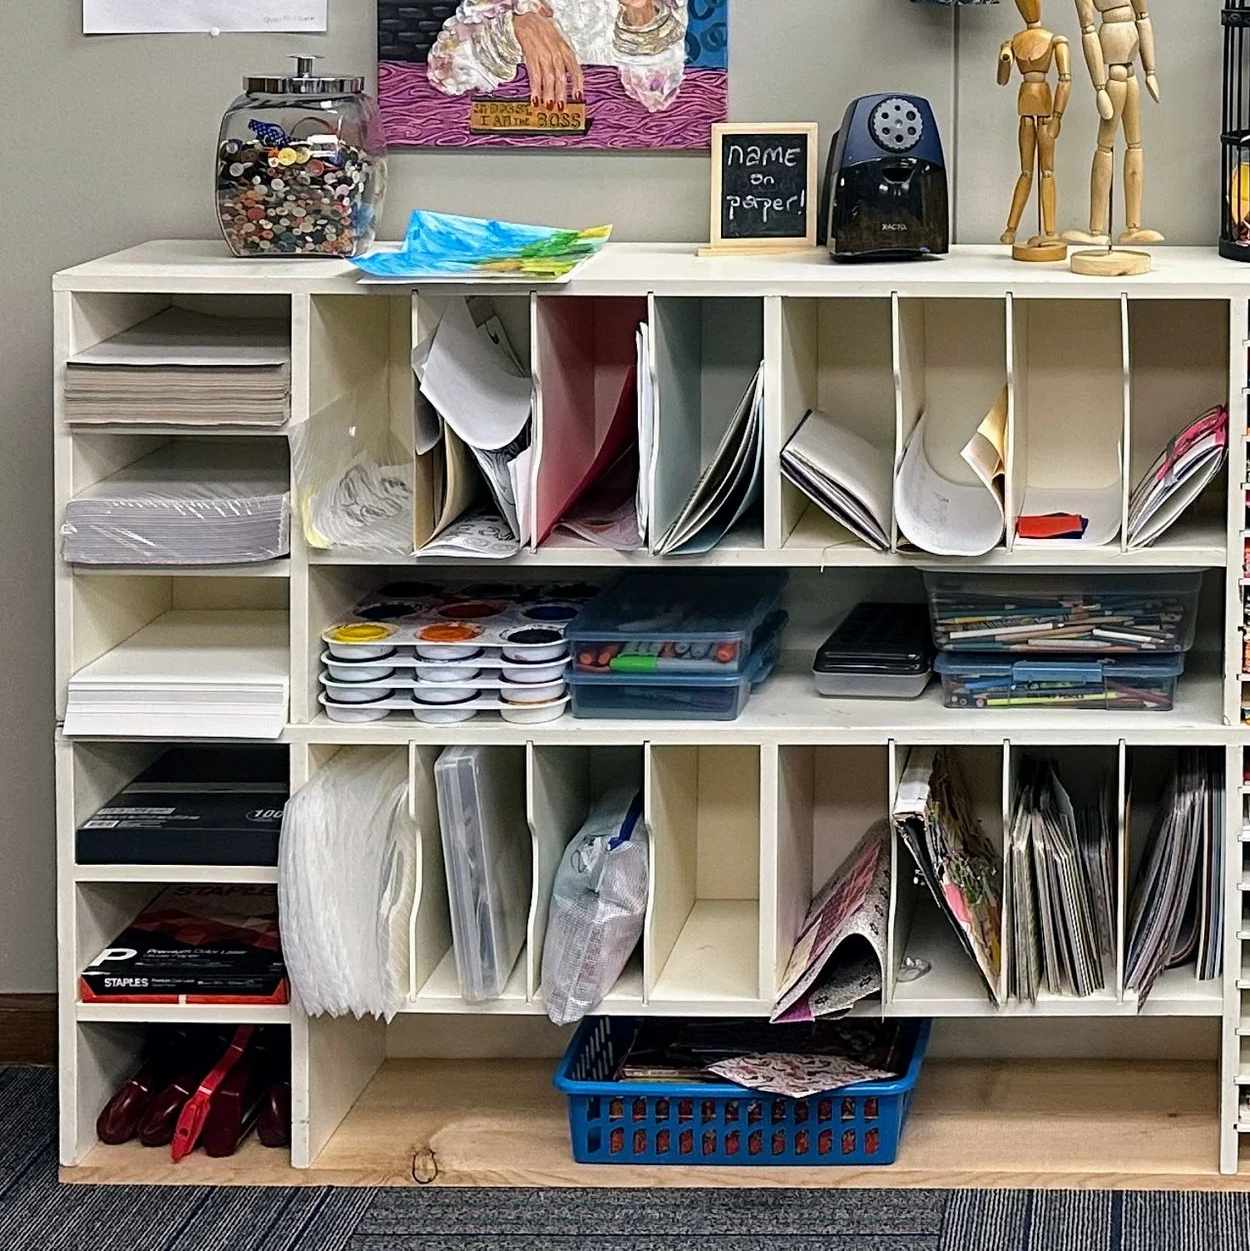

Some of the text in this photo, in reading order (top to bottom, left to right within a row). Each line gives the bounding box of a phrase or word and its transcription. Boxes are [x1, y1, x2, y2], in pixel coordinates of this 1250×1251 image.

[536, 112, 581, 129] BOSS
[726, 189, 805, 223] paper!
[104, 977, 149, 988] STAPLES
